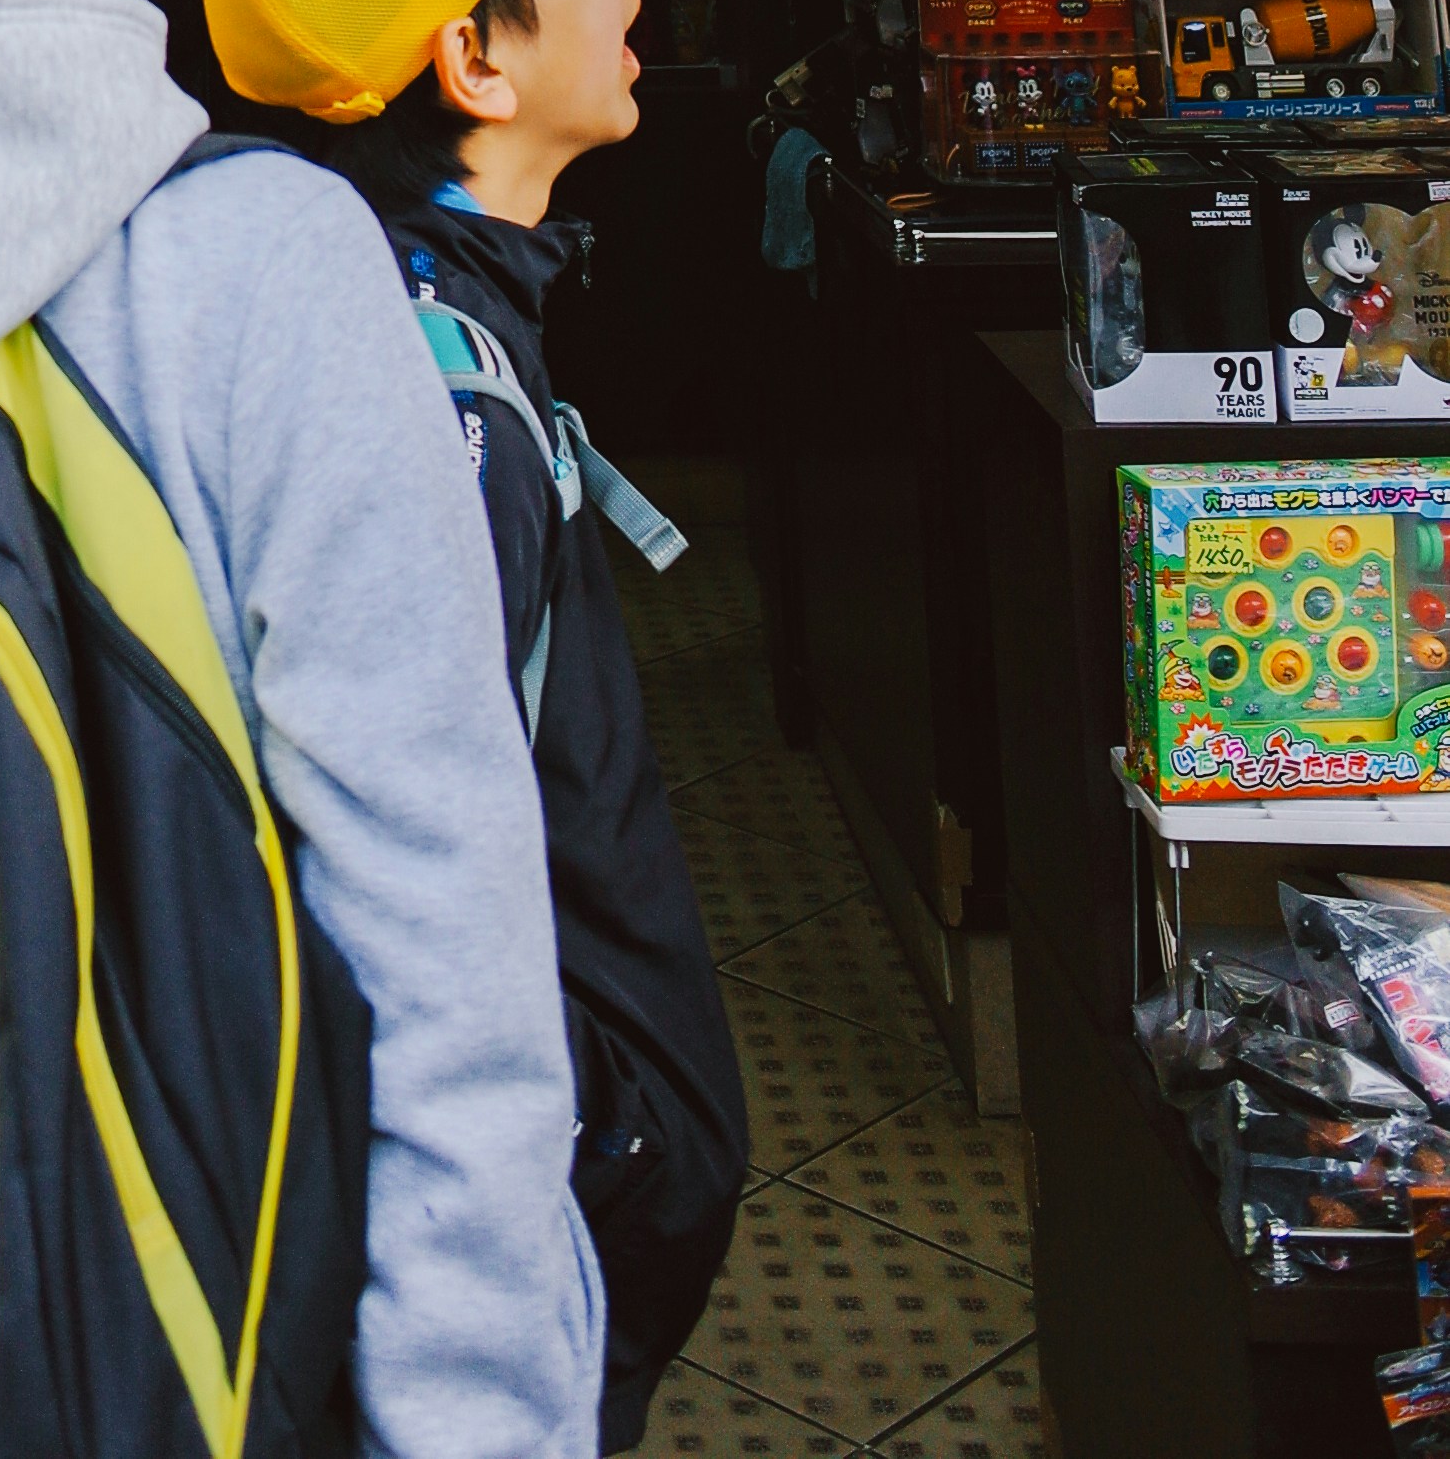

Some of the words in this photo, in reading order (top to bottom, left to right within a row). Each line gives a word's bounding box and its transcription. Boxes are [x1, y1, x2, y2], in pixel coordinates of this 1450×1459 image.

[1245, 101, 1362, 118] スーパージュニアシリーズ
[1190, 210, 1222, 219] MICKEY
[1223, 209, 1251, 218] MOUSE
[1213, 356, 1263, 392] 90
[1216, 394, 1265, 407] YEARS
[1226, 408, 1266, 418] MAGIC
[1171, 731, 1247, 778] いたずら
[1234, 749, 1420, 786] モグラたたきゲーム
